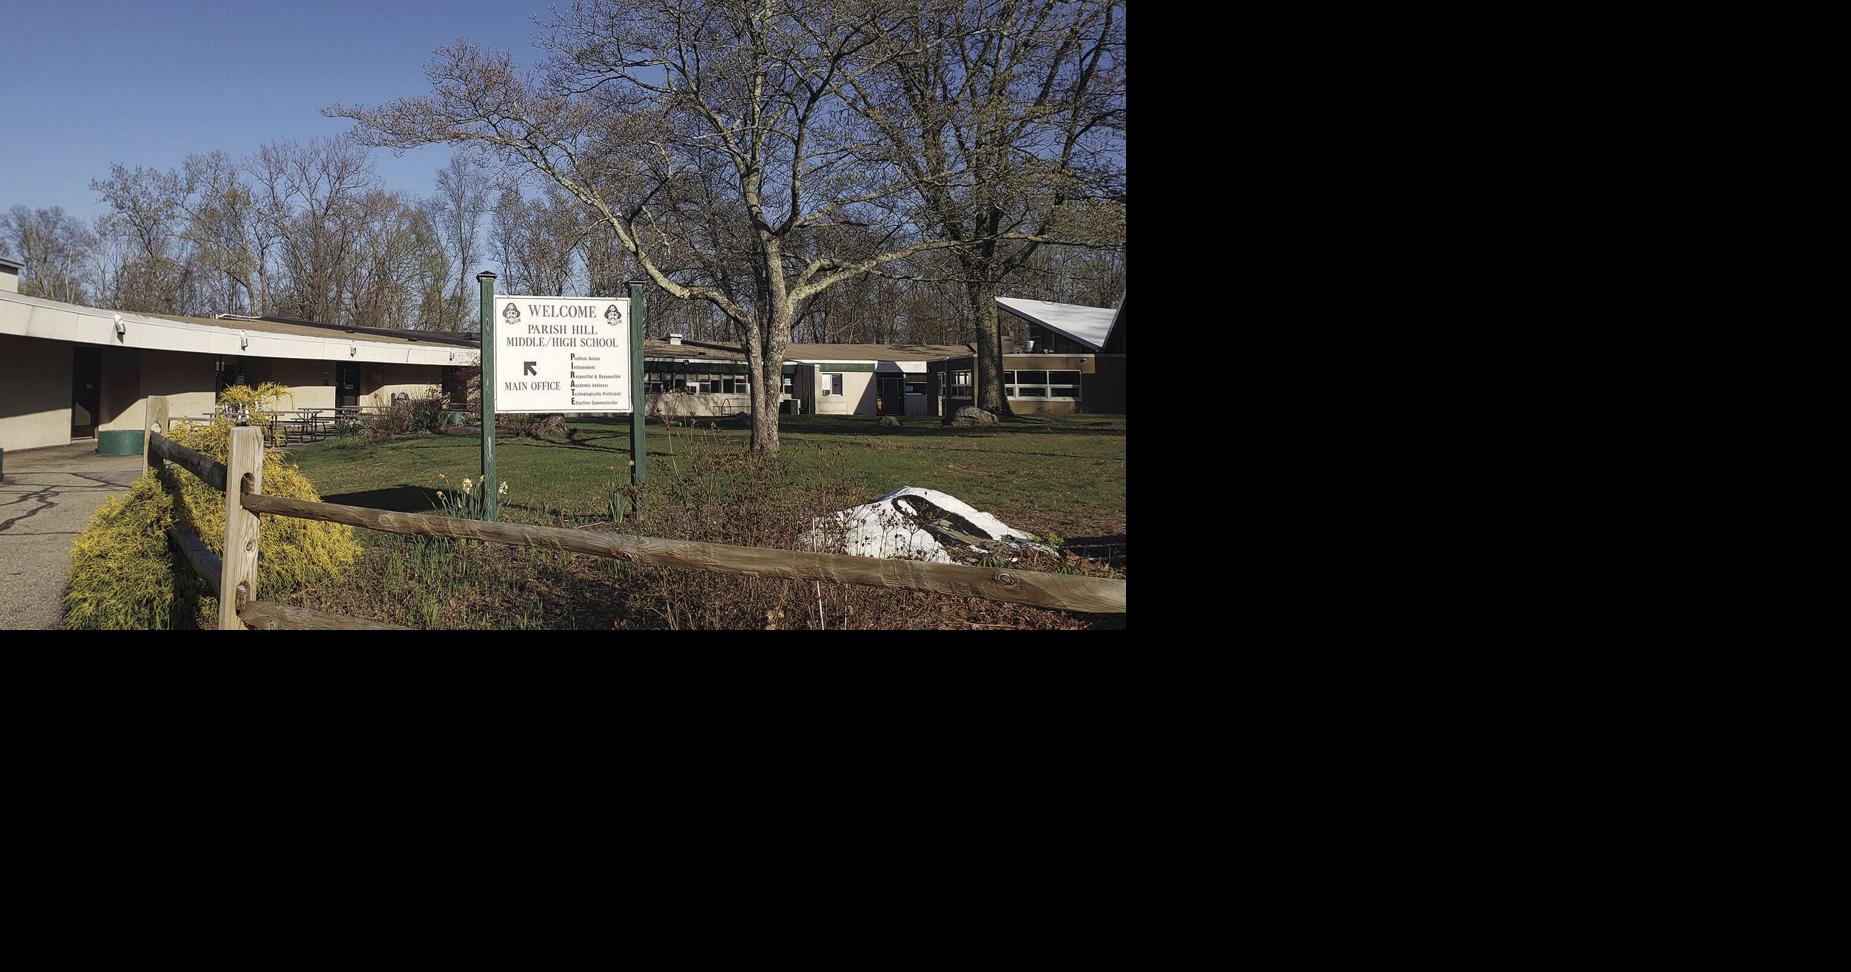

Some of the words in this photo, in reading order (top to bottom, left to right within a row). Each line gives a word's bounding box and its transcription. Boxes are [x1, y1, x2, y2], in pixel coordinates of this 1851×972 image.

[528, 304, 597, 318] WELCOME
[528, 324, 567, 335] PARISH
[572, 325, 598, 335] HILL
[506, 337, 577, 347] MIDDLE/HIGH
[580, 338, 618, 348] SCHOOL
[505, 381, 528, 391] MAIN
[531, 381, 561, 391] OFFICE
